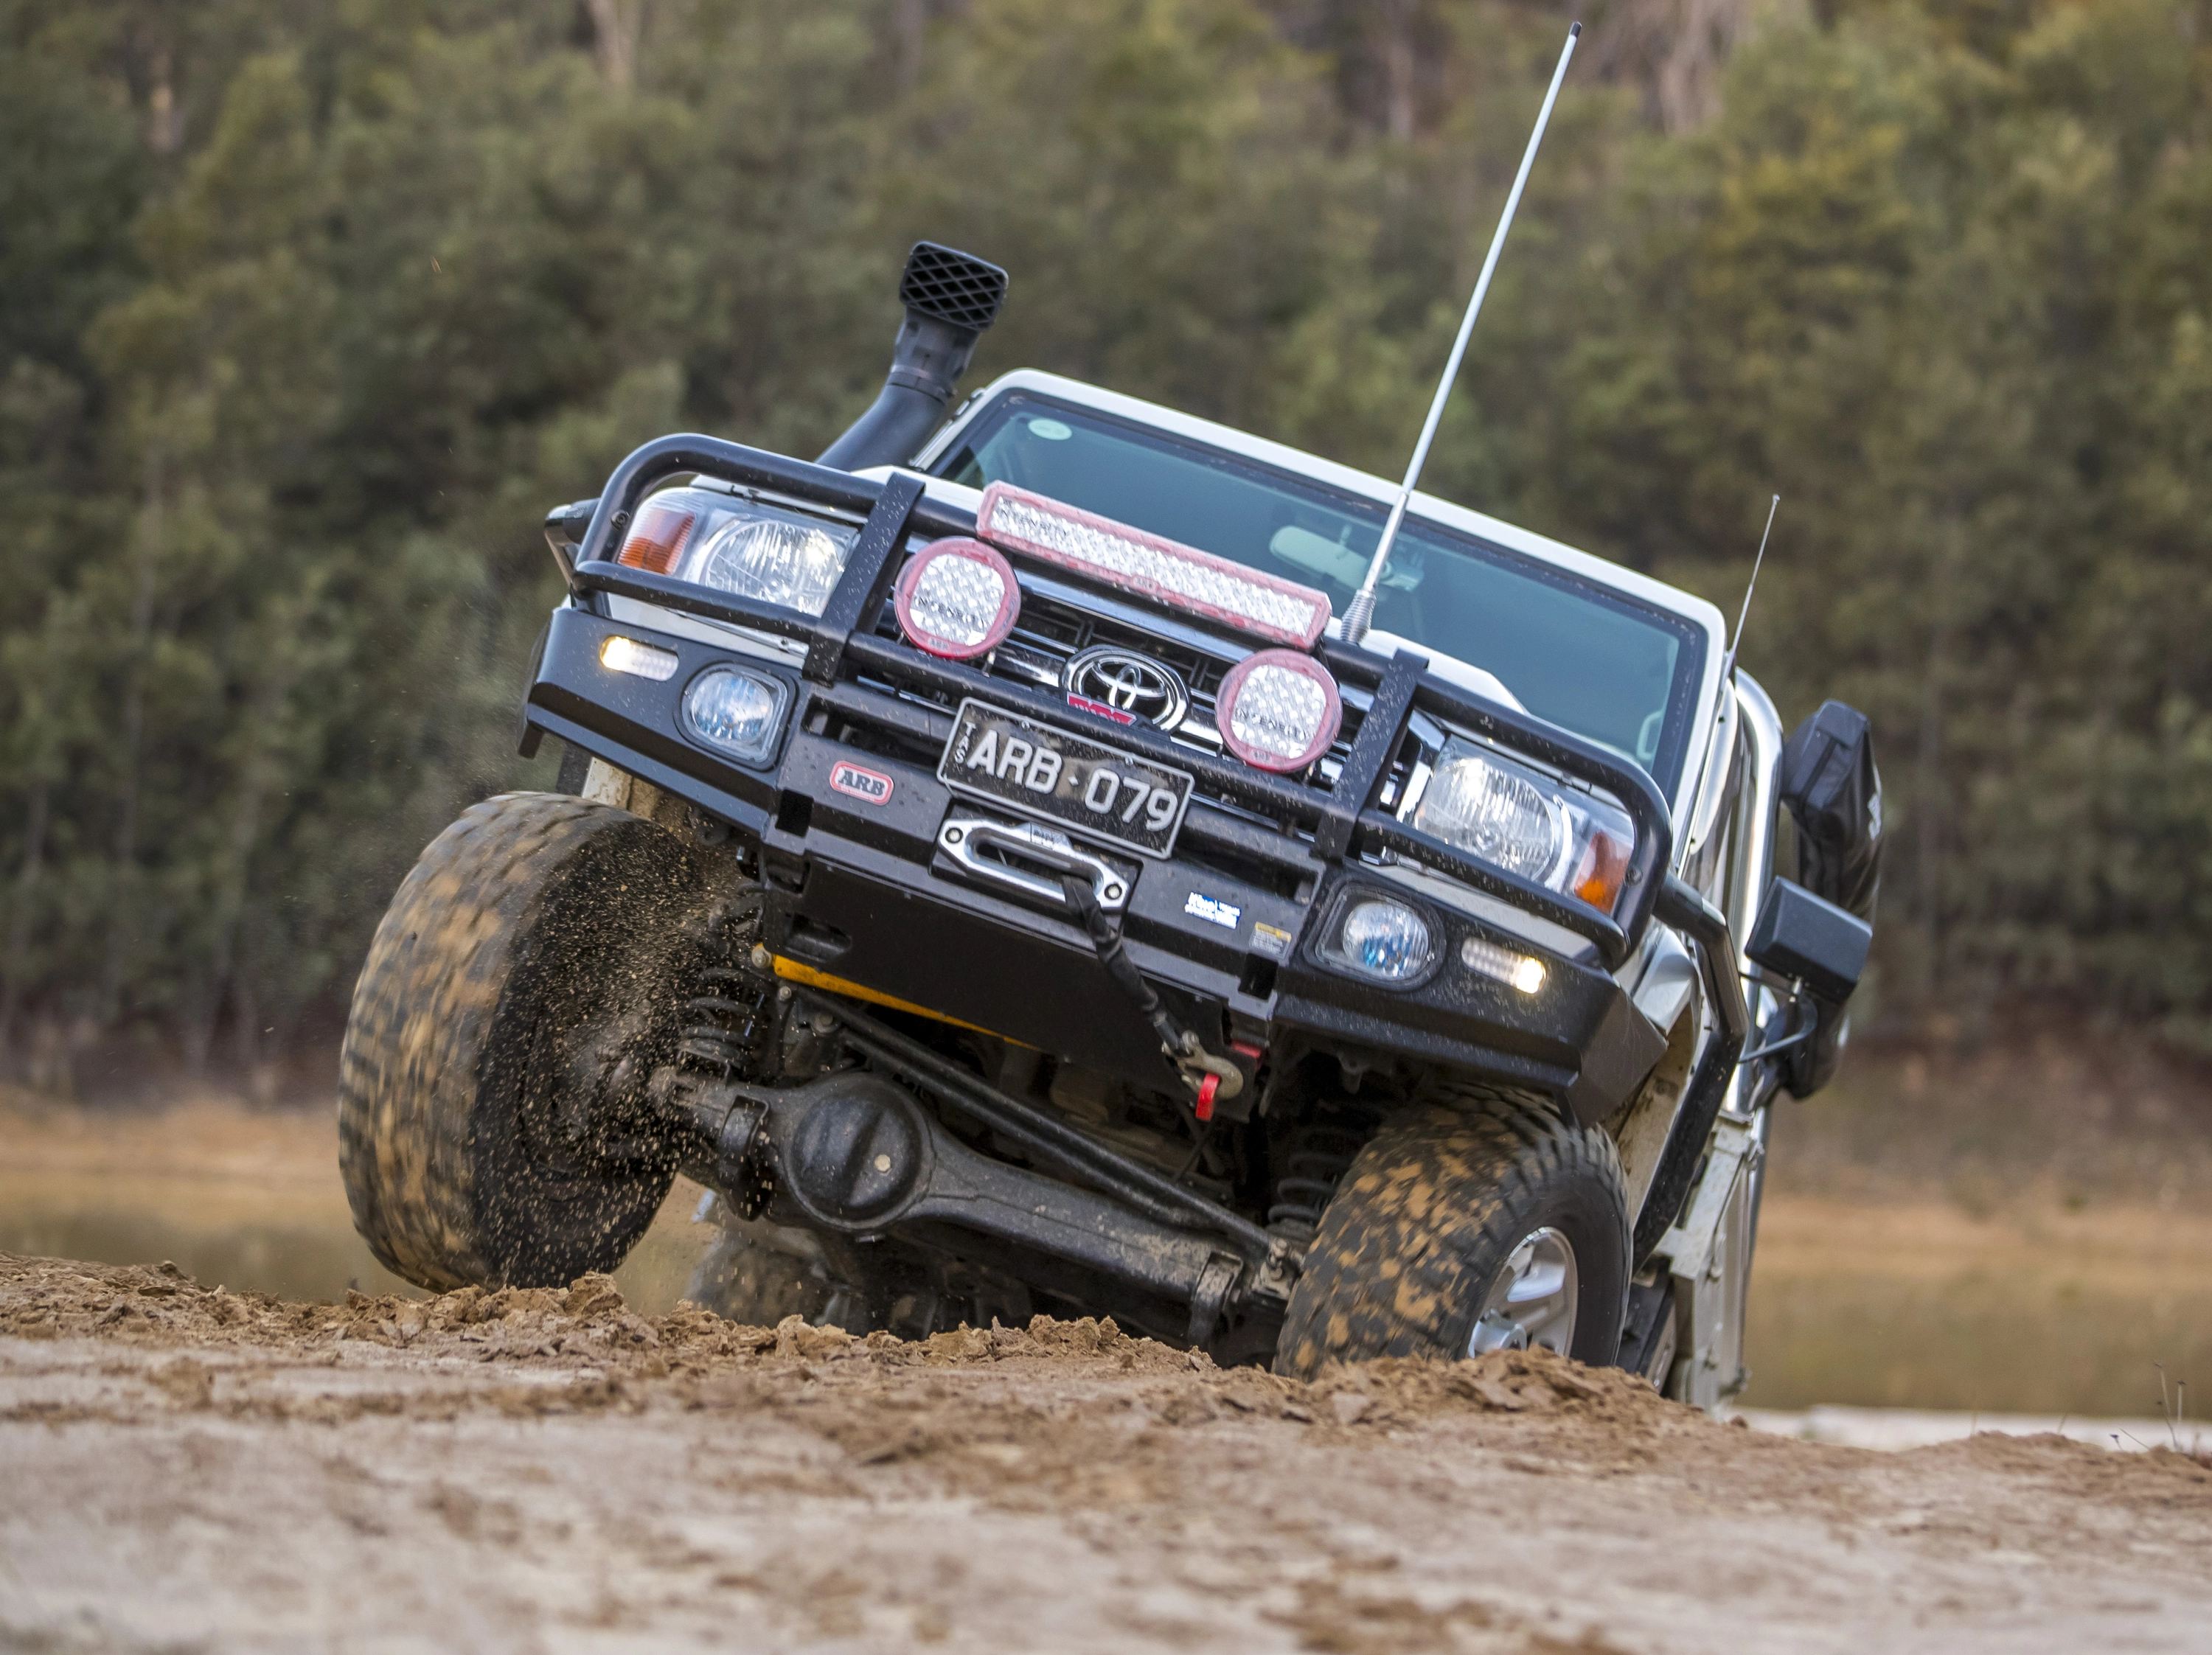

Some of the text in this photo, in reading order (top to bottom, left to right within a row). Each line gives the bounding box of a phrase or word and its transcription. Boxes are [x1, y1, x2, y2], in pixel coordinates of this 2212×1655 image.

[954, 721, 977, 764] TAS
[838, 770, 886, 796] ARB
[966, 728, 1178, 832] ARB 079
